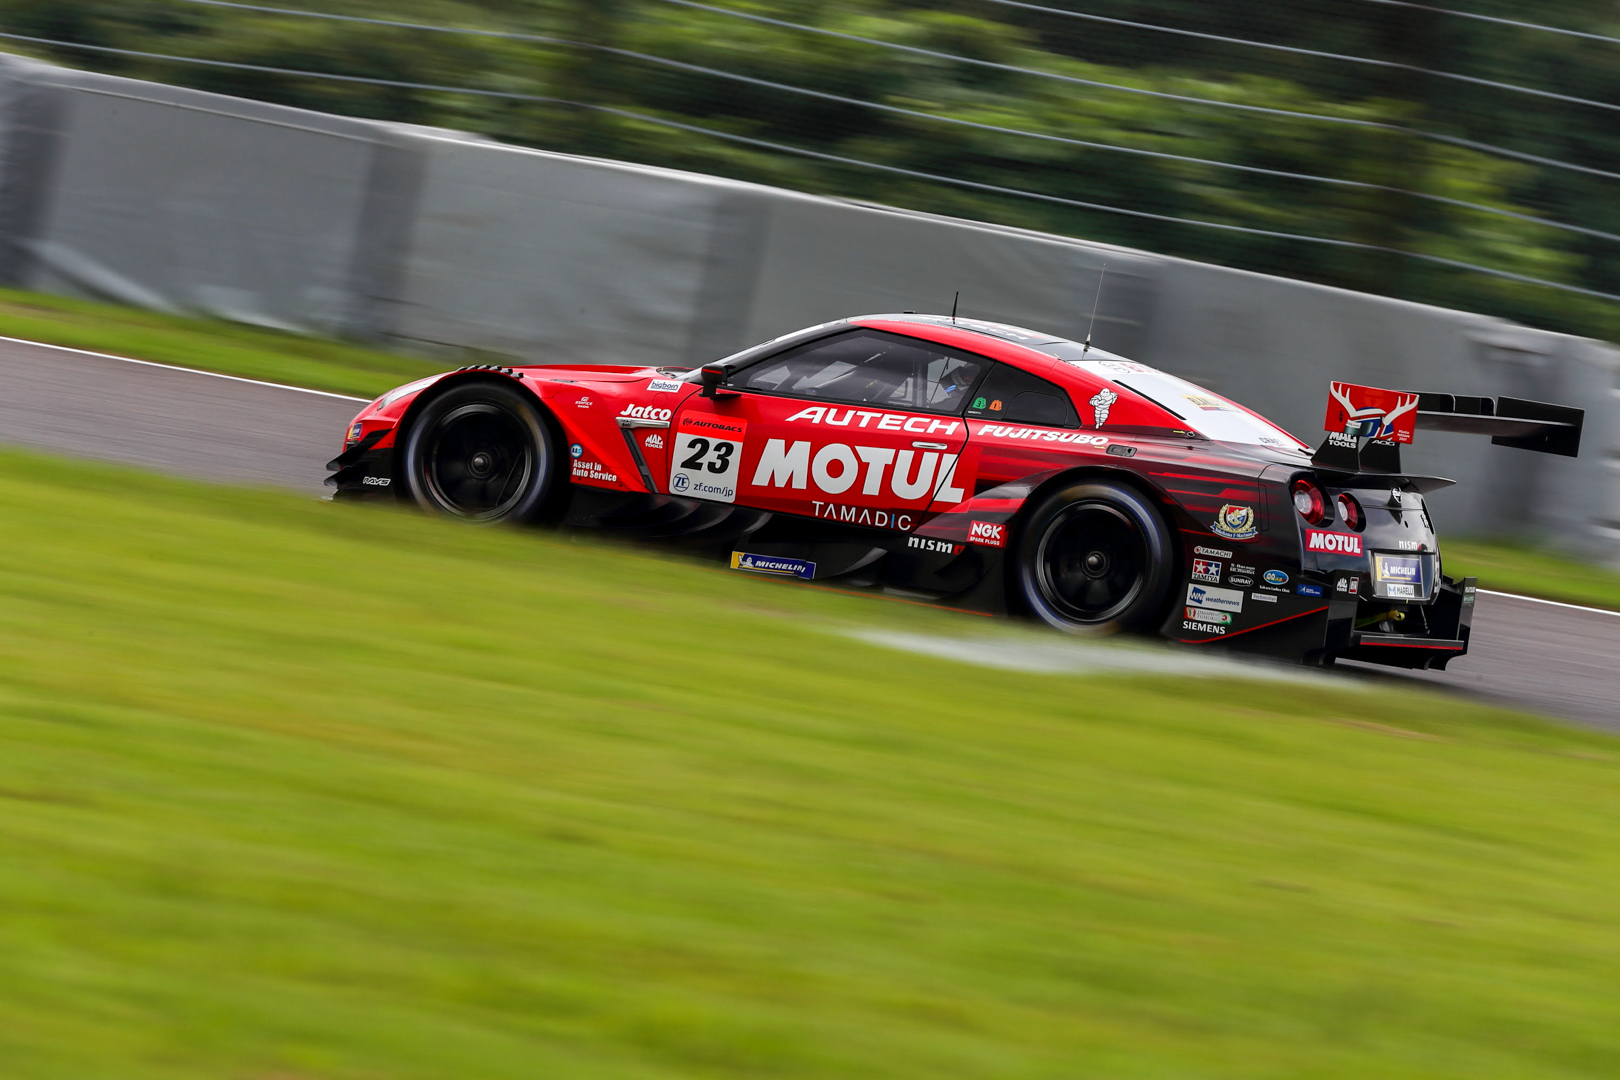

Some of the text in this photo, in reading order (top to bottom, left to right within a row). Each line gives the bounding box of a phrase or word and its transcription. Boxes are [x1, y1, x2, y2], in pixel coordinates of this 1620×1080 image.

[620, 403, 672, 421] Jatco
[693, 420, 744, 433] AUTOBACS
[785, 406, 960, 435] AUTECH
[645, 434, 663, 445] MAC
[977, 424, 1109, 446] FUJITSUBO
[1329, 439, 1357, 449] TOOLS
[680, 437, 735, 475] 23
[572, 459, 602, 472] Asset in
[751, 438, 965, 504] MOTUL
[362, 476, 391, 487] RAYS
[571, 467, 617, 483] Auto Service
[675, 476, 734, 498] ZF zf.com/jp
[811, 501, 912, 531] TAMADIC
[971, 522, 1003, 540] NGK
[907, 536, 966, 555] nismo
[969, 536, 985, 544] SPARK
[1309, 532, 1361, 554] MOTUL
[1201, 547, 1232, 558] TAMACHI
[755, 560, 806, 573] MICHELIN
[1389, 566, 1416, 576] MICHELIN
[1192, 573, 1219, 583] TAMIYA
[1230, 577, 1252, 586] SUNRAY
[1396, 585, 1414, 596] MARELLI
[1205, 596, 1240, 607] weathernews
[1182, 620, 1226, 635] SIEMENS
